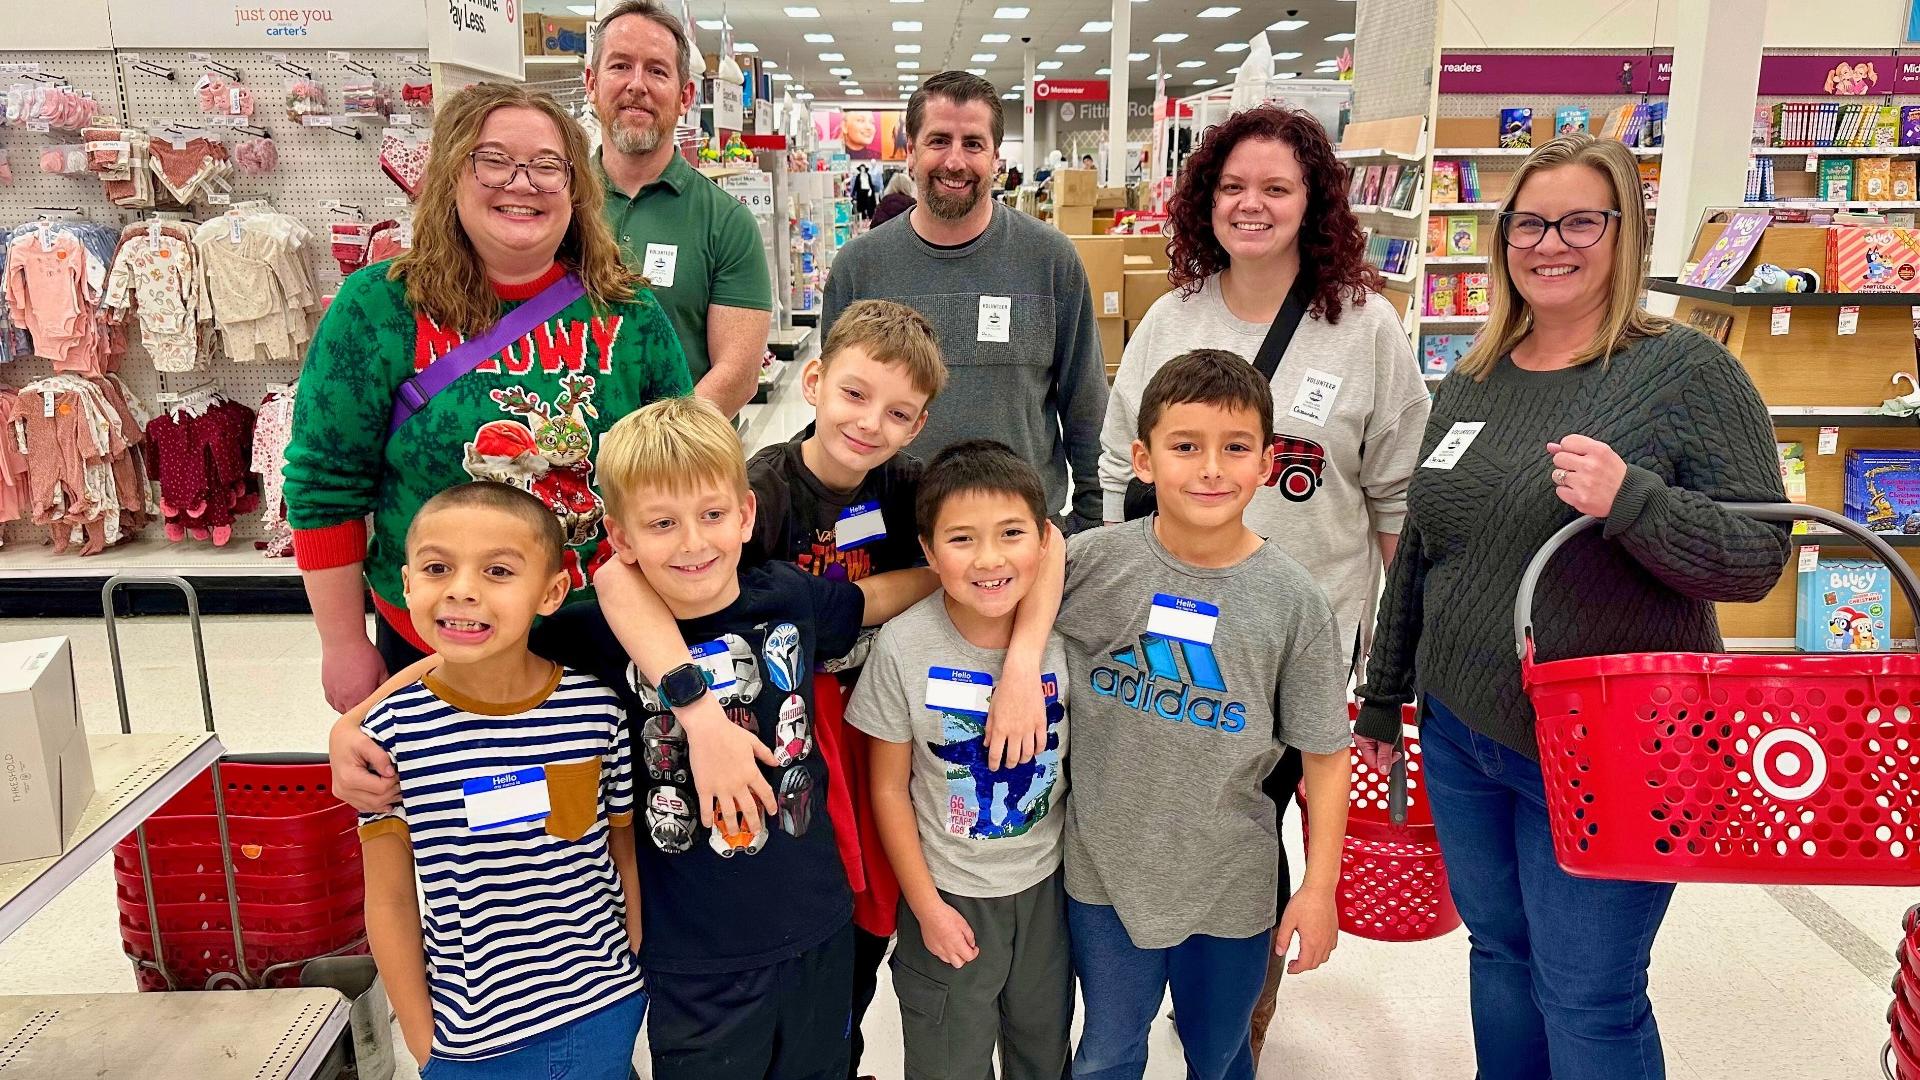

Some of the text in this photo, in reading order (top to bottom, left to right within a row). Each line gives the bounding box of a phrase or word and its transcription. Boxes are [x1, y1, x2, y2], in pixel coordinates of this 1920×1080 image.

[235, 5, 333, 26] just one you
[266, 26, 307, 36] carter's
[1444, 62, 1483, 73] readers
[1050, 86, 1085, 94] Menswear
[413, 313, 624, 376] MOWY
[1306, 376, 1337, 391] VOLUNTEER
[849, 504, 866, 514] Hello
[1830, 571, 1877, 593] BLUEY
[1176, 598, 1197, 609] Hello
[952, 670, 972, 680] Hello
[1090, 666, 1247, 733] adidas
[5, 753, 21, 802] THRESHOLD
[492, 774, 518, 786] Hello
[950, 794, 965, 810] 66
[950, 808, 977, 818] MILLION
[951, 815, 973, 827] YEARS
[950, 823, 965, 835] AGO
